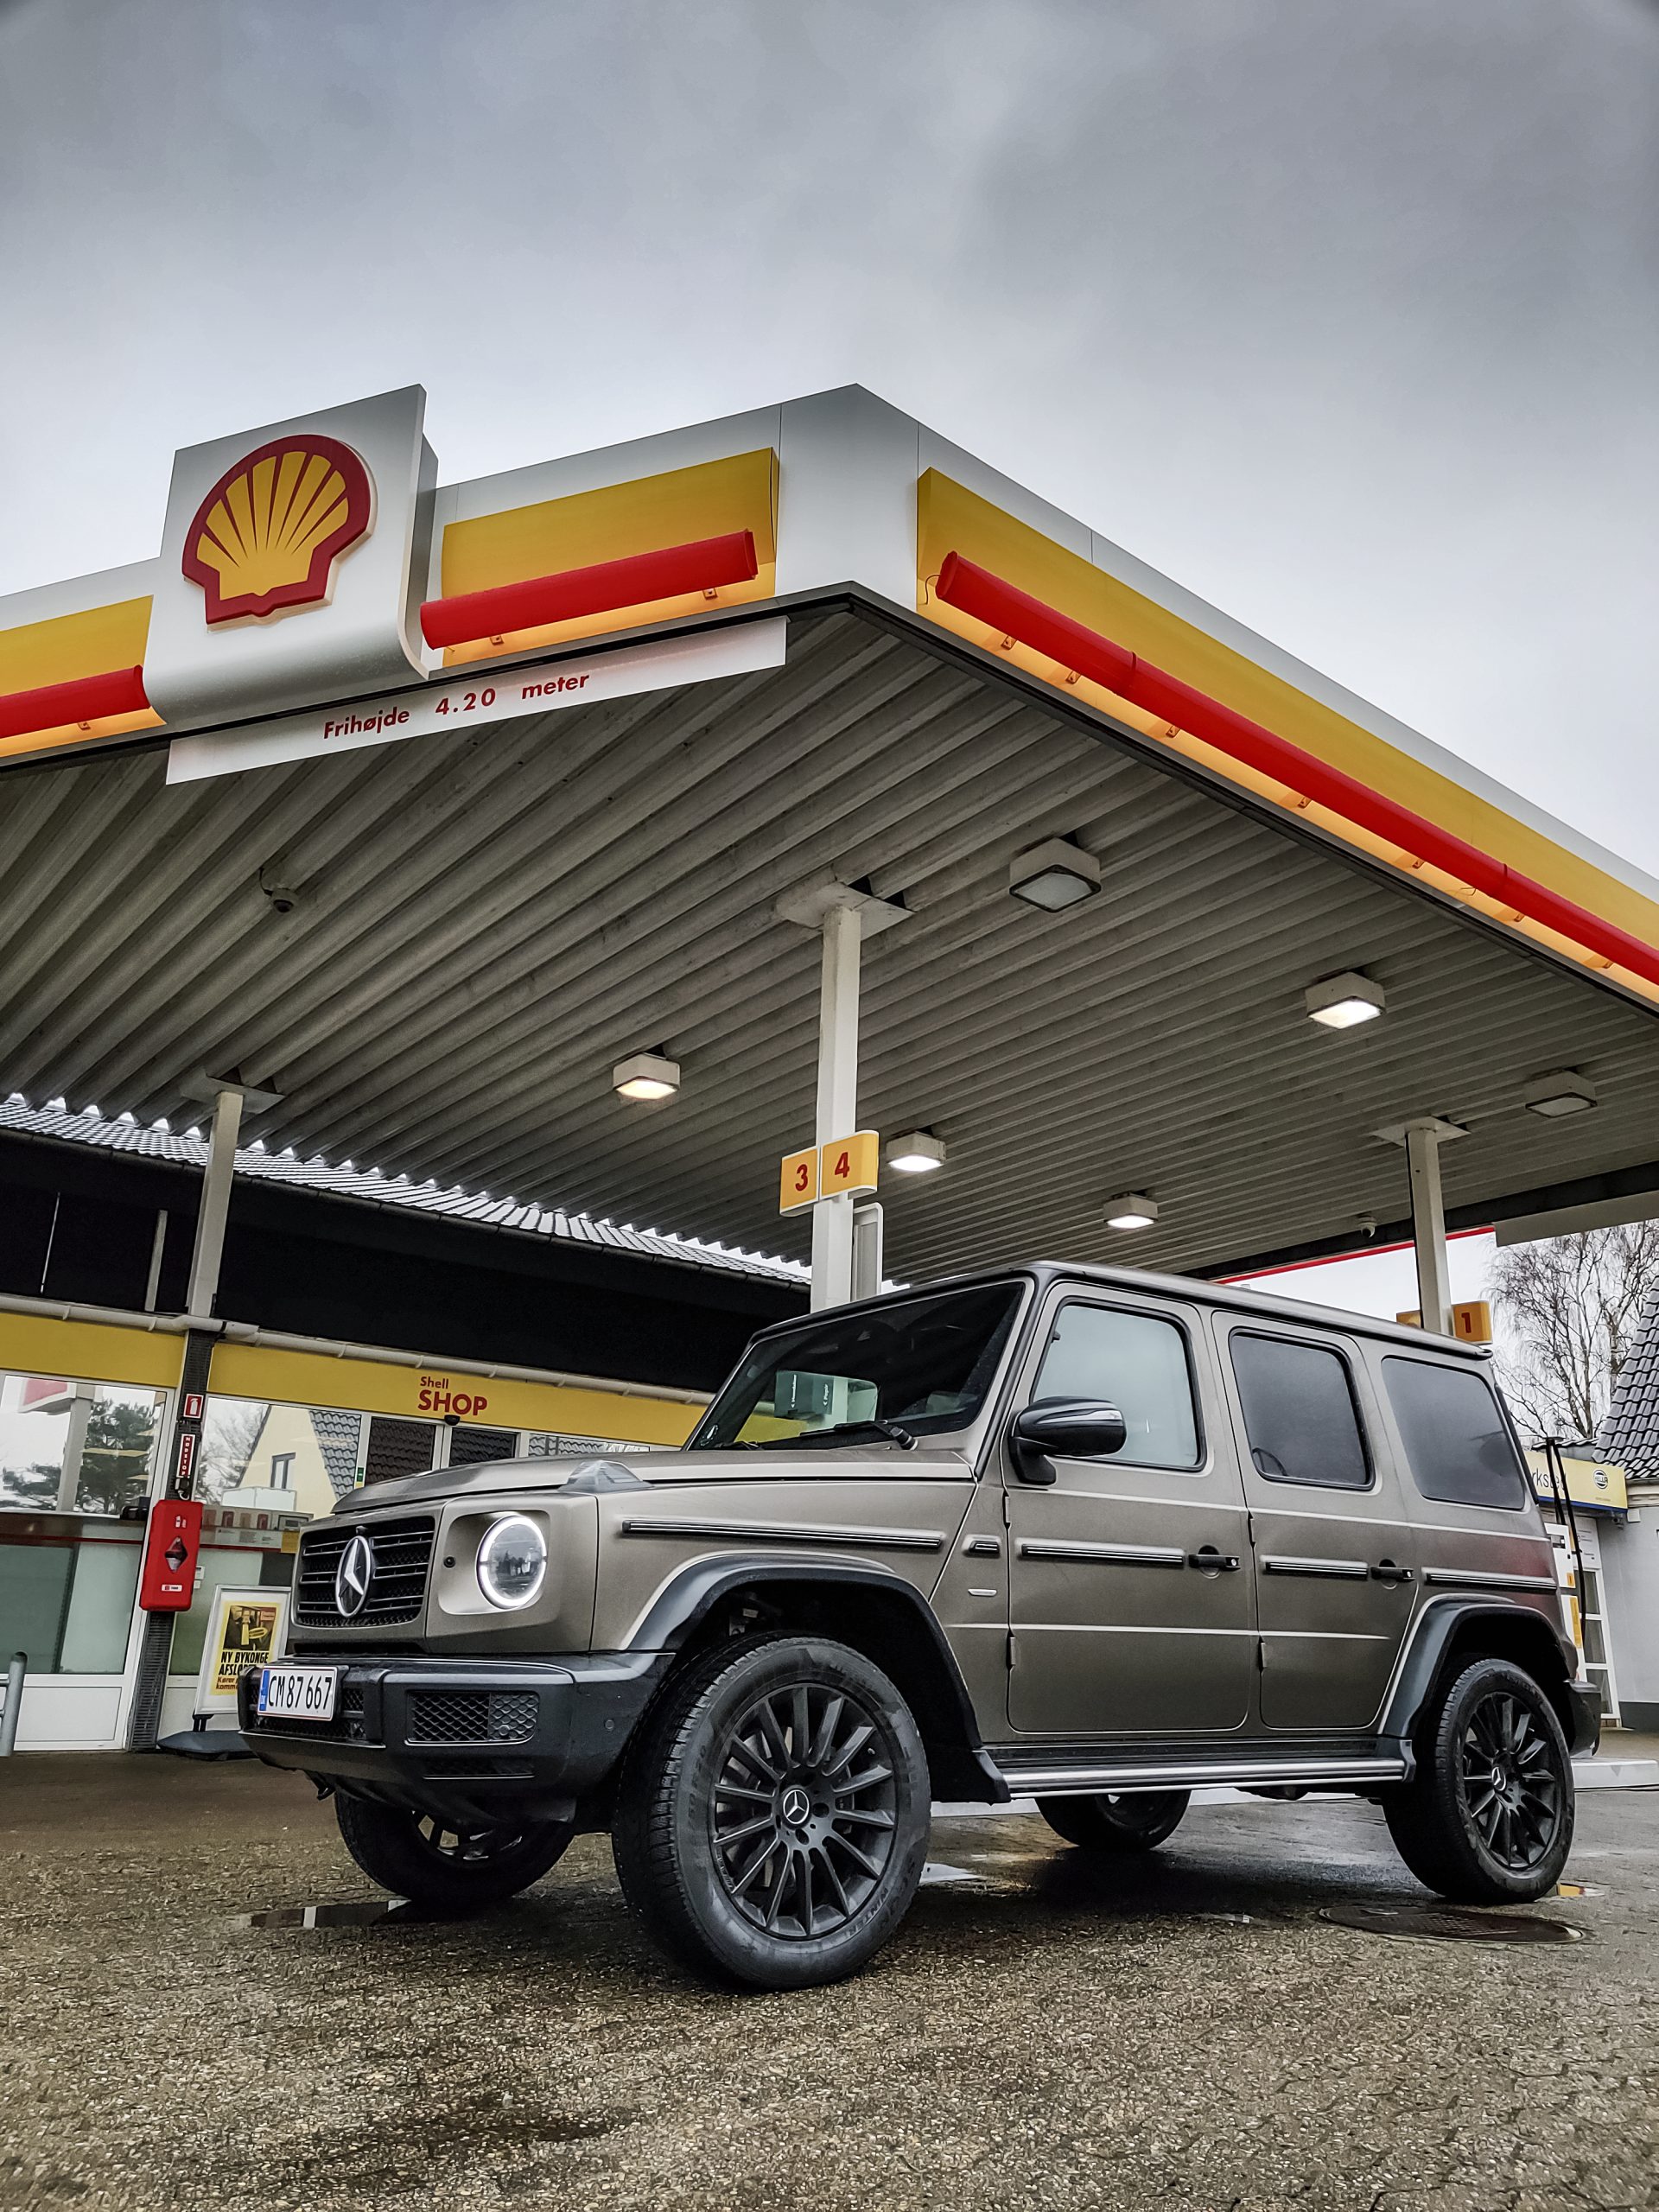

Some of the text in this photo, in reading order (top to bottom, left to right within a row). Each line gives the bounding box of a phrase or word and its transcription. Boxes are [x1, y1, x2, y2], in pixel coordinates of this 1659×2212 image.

[323, 674, 590, 740] Frihøjde 4.20 meter
[795, 1163, 809, 1192] 3
[834, 1151, 850, 1179] 4
[1461, 1312, 1472, 1334] 1
[420, 1376, 449, 1389] Shell
[417, 1389, 488, 1416] SHOP
[220, 1651, 270, 1664] NY BYKONGE
[268, 1675, 333, 1710] CM 87 667
